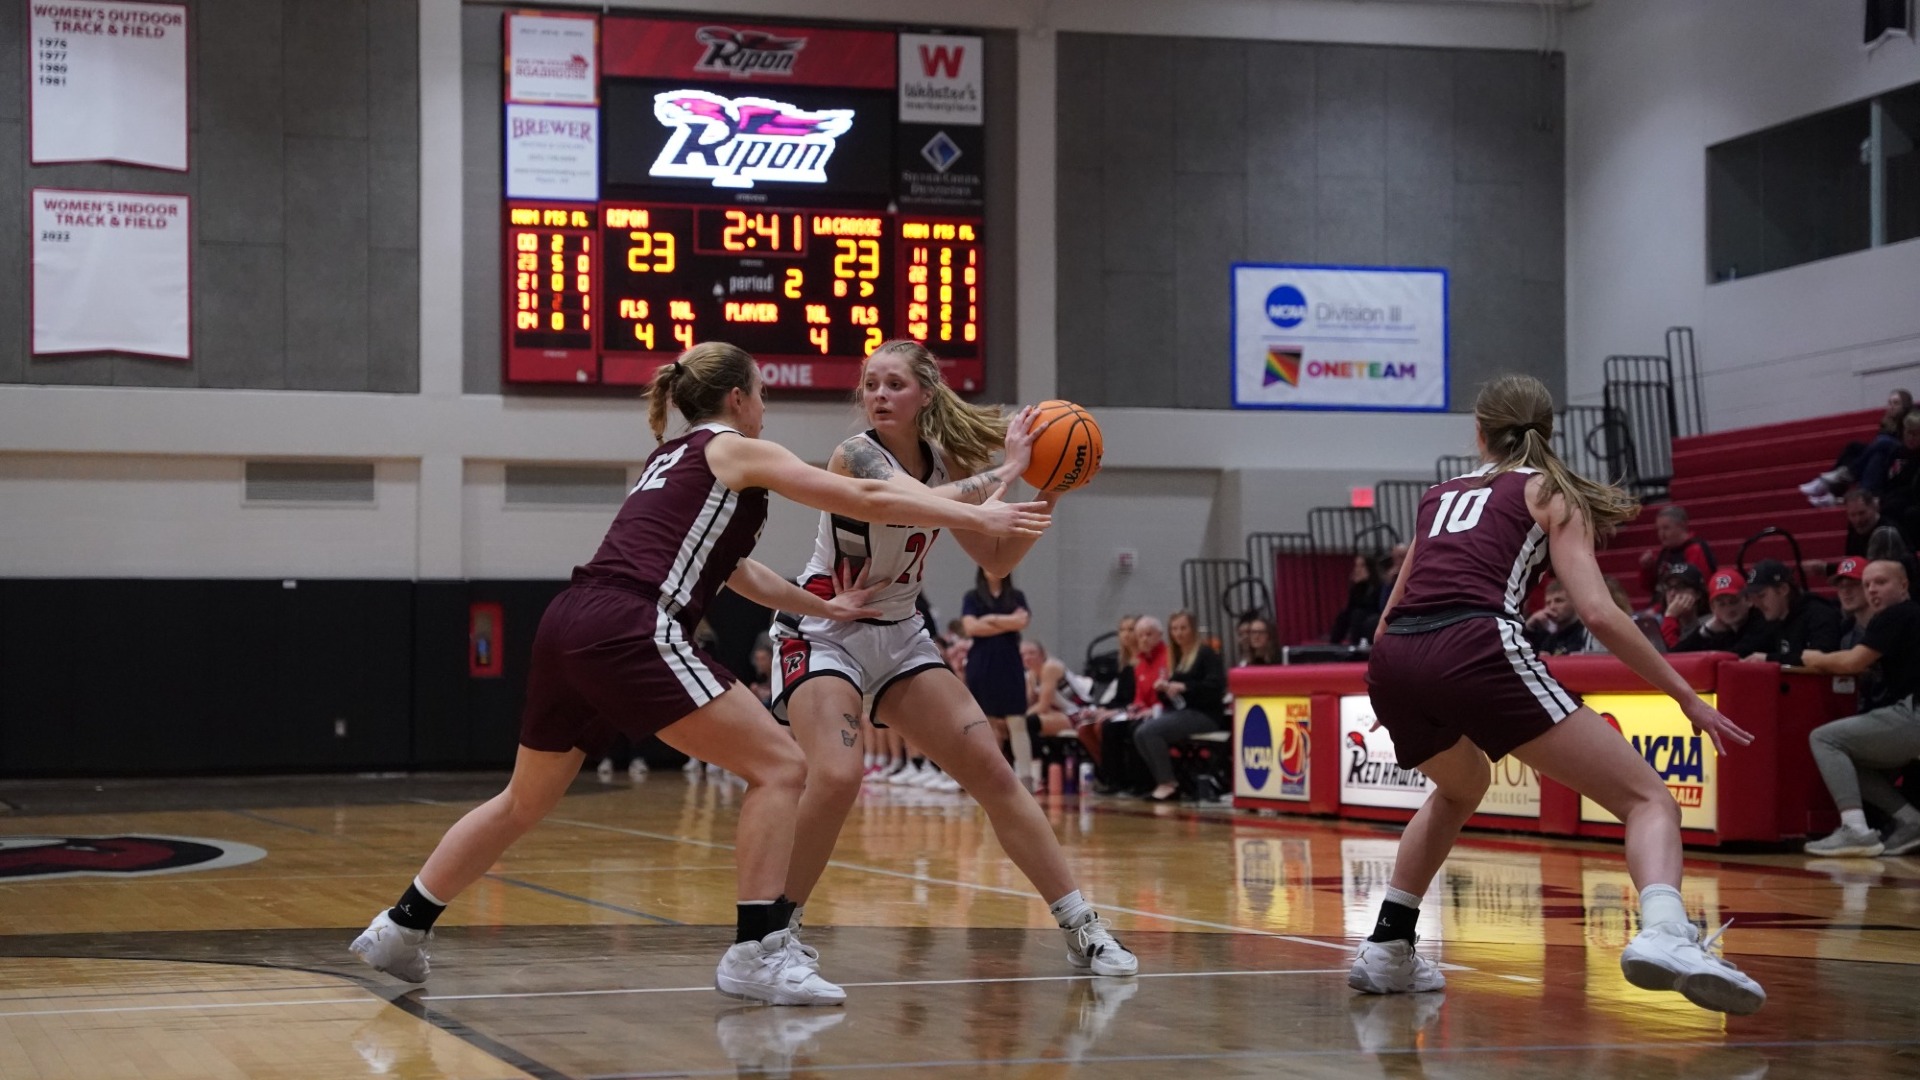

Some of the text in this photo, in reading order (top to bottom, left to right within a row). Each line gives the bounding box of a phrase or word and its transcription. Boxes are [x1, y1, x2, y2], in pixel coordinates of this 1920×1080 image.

[34, 4, 182, 26] WOMEN'S OUTDOOR
[54, 20, 165, 39] TRACK & FIELD
[38, 50, 67, 61] 1977
[700, 38, 796, 74] Ripon
[919, 43, 965, 80] W
[512, 117, 592, 143] BREWER
[660, 112, 834, 180] Ripon
[44, 198, 178, 217] WOMEN'S INDOOR
[544, 210, 567, 226] PTS
[571, 211, 589, 227] FL
[606, 208, 649, 228] RIPON
[56, 213, 168, 230] TRACK & FIELD
[724, 210, 802, 251] 2:41
[551, 234, 564, 253] 2
[583, 236, 590, 253] 1
[628, 231, 675, 273] 23
[577, 254, 590, 273] 0
[834, 239, 880, 279] 23
[551, 273, 564, 292] 0
[577, 274, 590, 293] 0
[729, 275, 774, 294] period
[784, 268, 804, 298] 2
[583, 294, 590, 311] 1
[620, 299, 649, 319] FLS
[725, 302, 778, 322] PLAYER
[1268, 304, 1307, 320] NCAA
[1315, 302, 1384, 323] Division
[551, 311, 564, 330] 0
[583, 313, 590, 330] 1
[851, 306, 879, 325] FLS
[635, 323, 654, 350] 4
[674, 324, 693, 350] 4
[809, 327, 829, 354] 4
[864, 327, 883, 356] 2
[760, 363, 813, 388] ONE
[1307, 361, 1416, 380] ONETEAM
[1049, 444, 1088, 493] Wilson
[1428, 487, 1493, 539] 10
[1243, 746, 1272, 770] NCAA
[1347, 741, 1428, 788] RED HAWKS
[1631, 735, 1703, 783] NCAA
